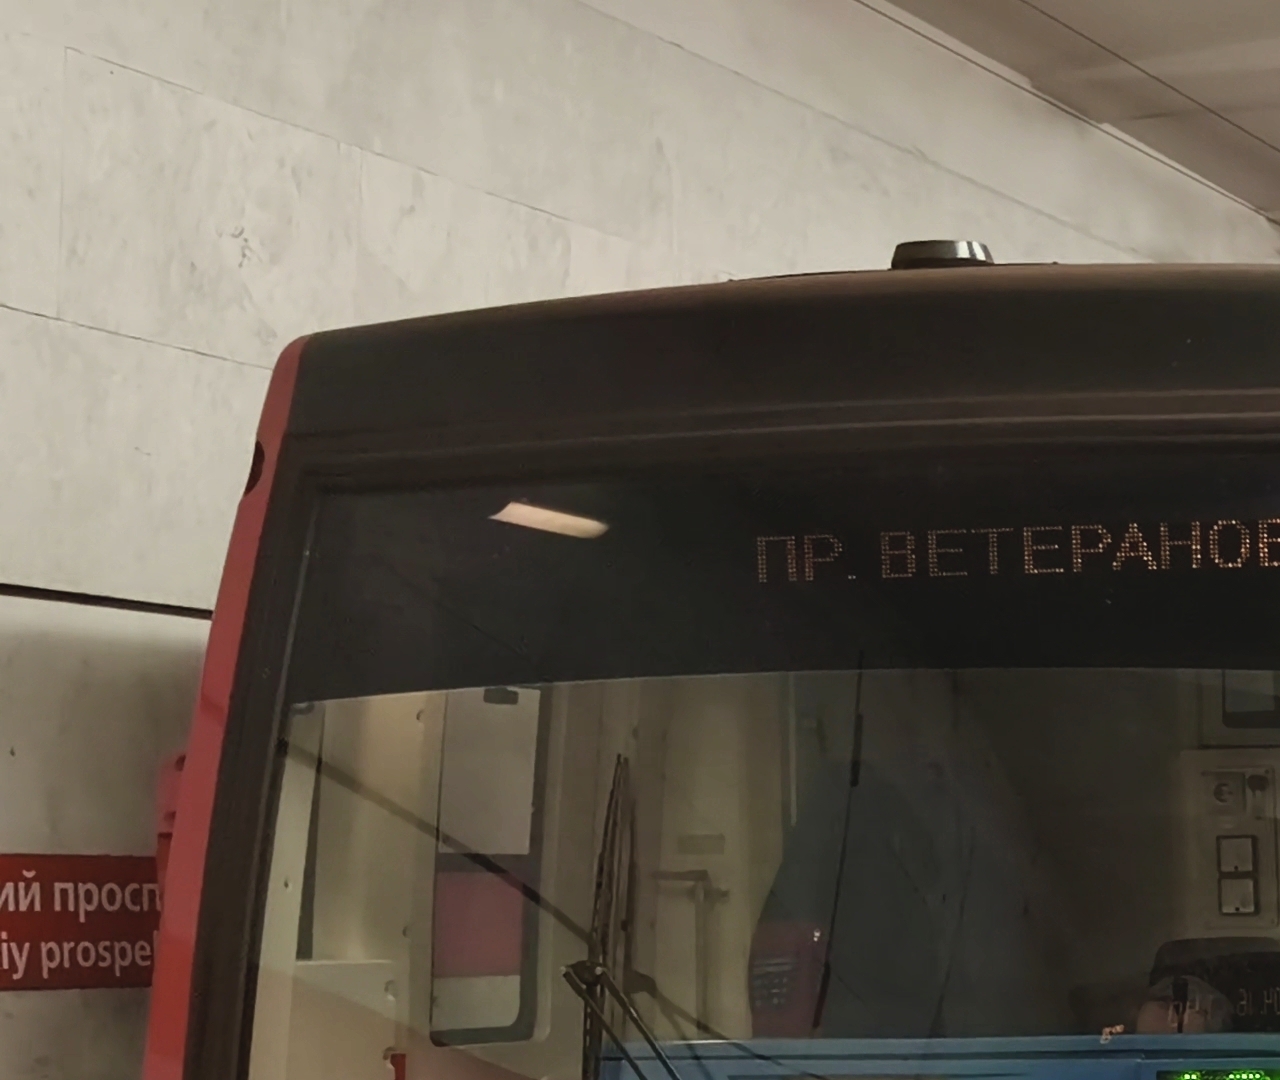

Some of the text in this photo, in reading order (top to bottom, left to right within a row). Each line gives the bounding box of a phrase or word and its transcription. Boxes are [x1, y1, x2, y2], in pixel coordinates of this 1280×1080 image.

[756, 534, 857, 583] ПР.
[53, 881, 161, 924] просп
[40, 929, 159, 980] prospe
